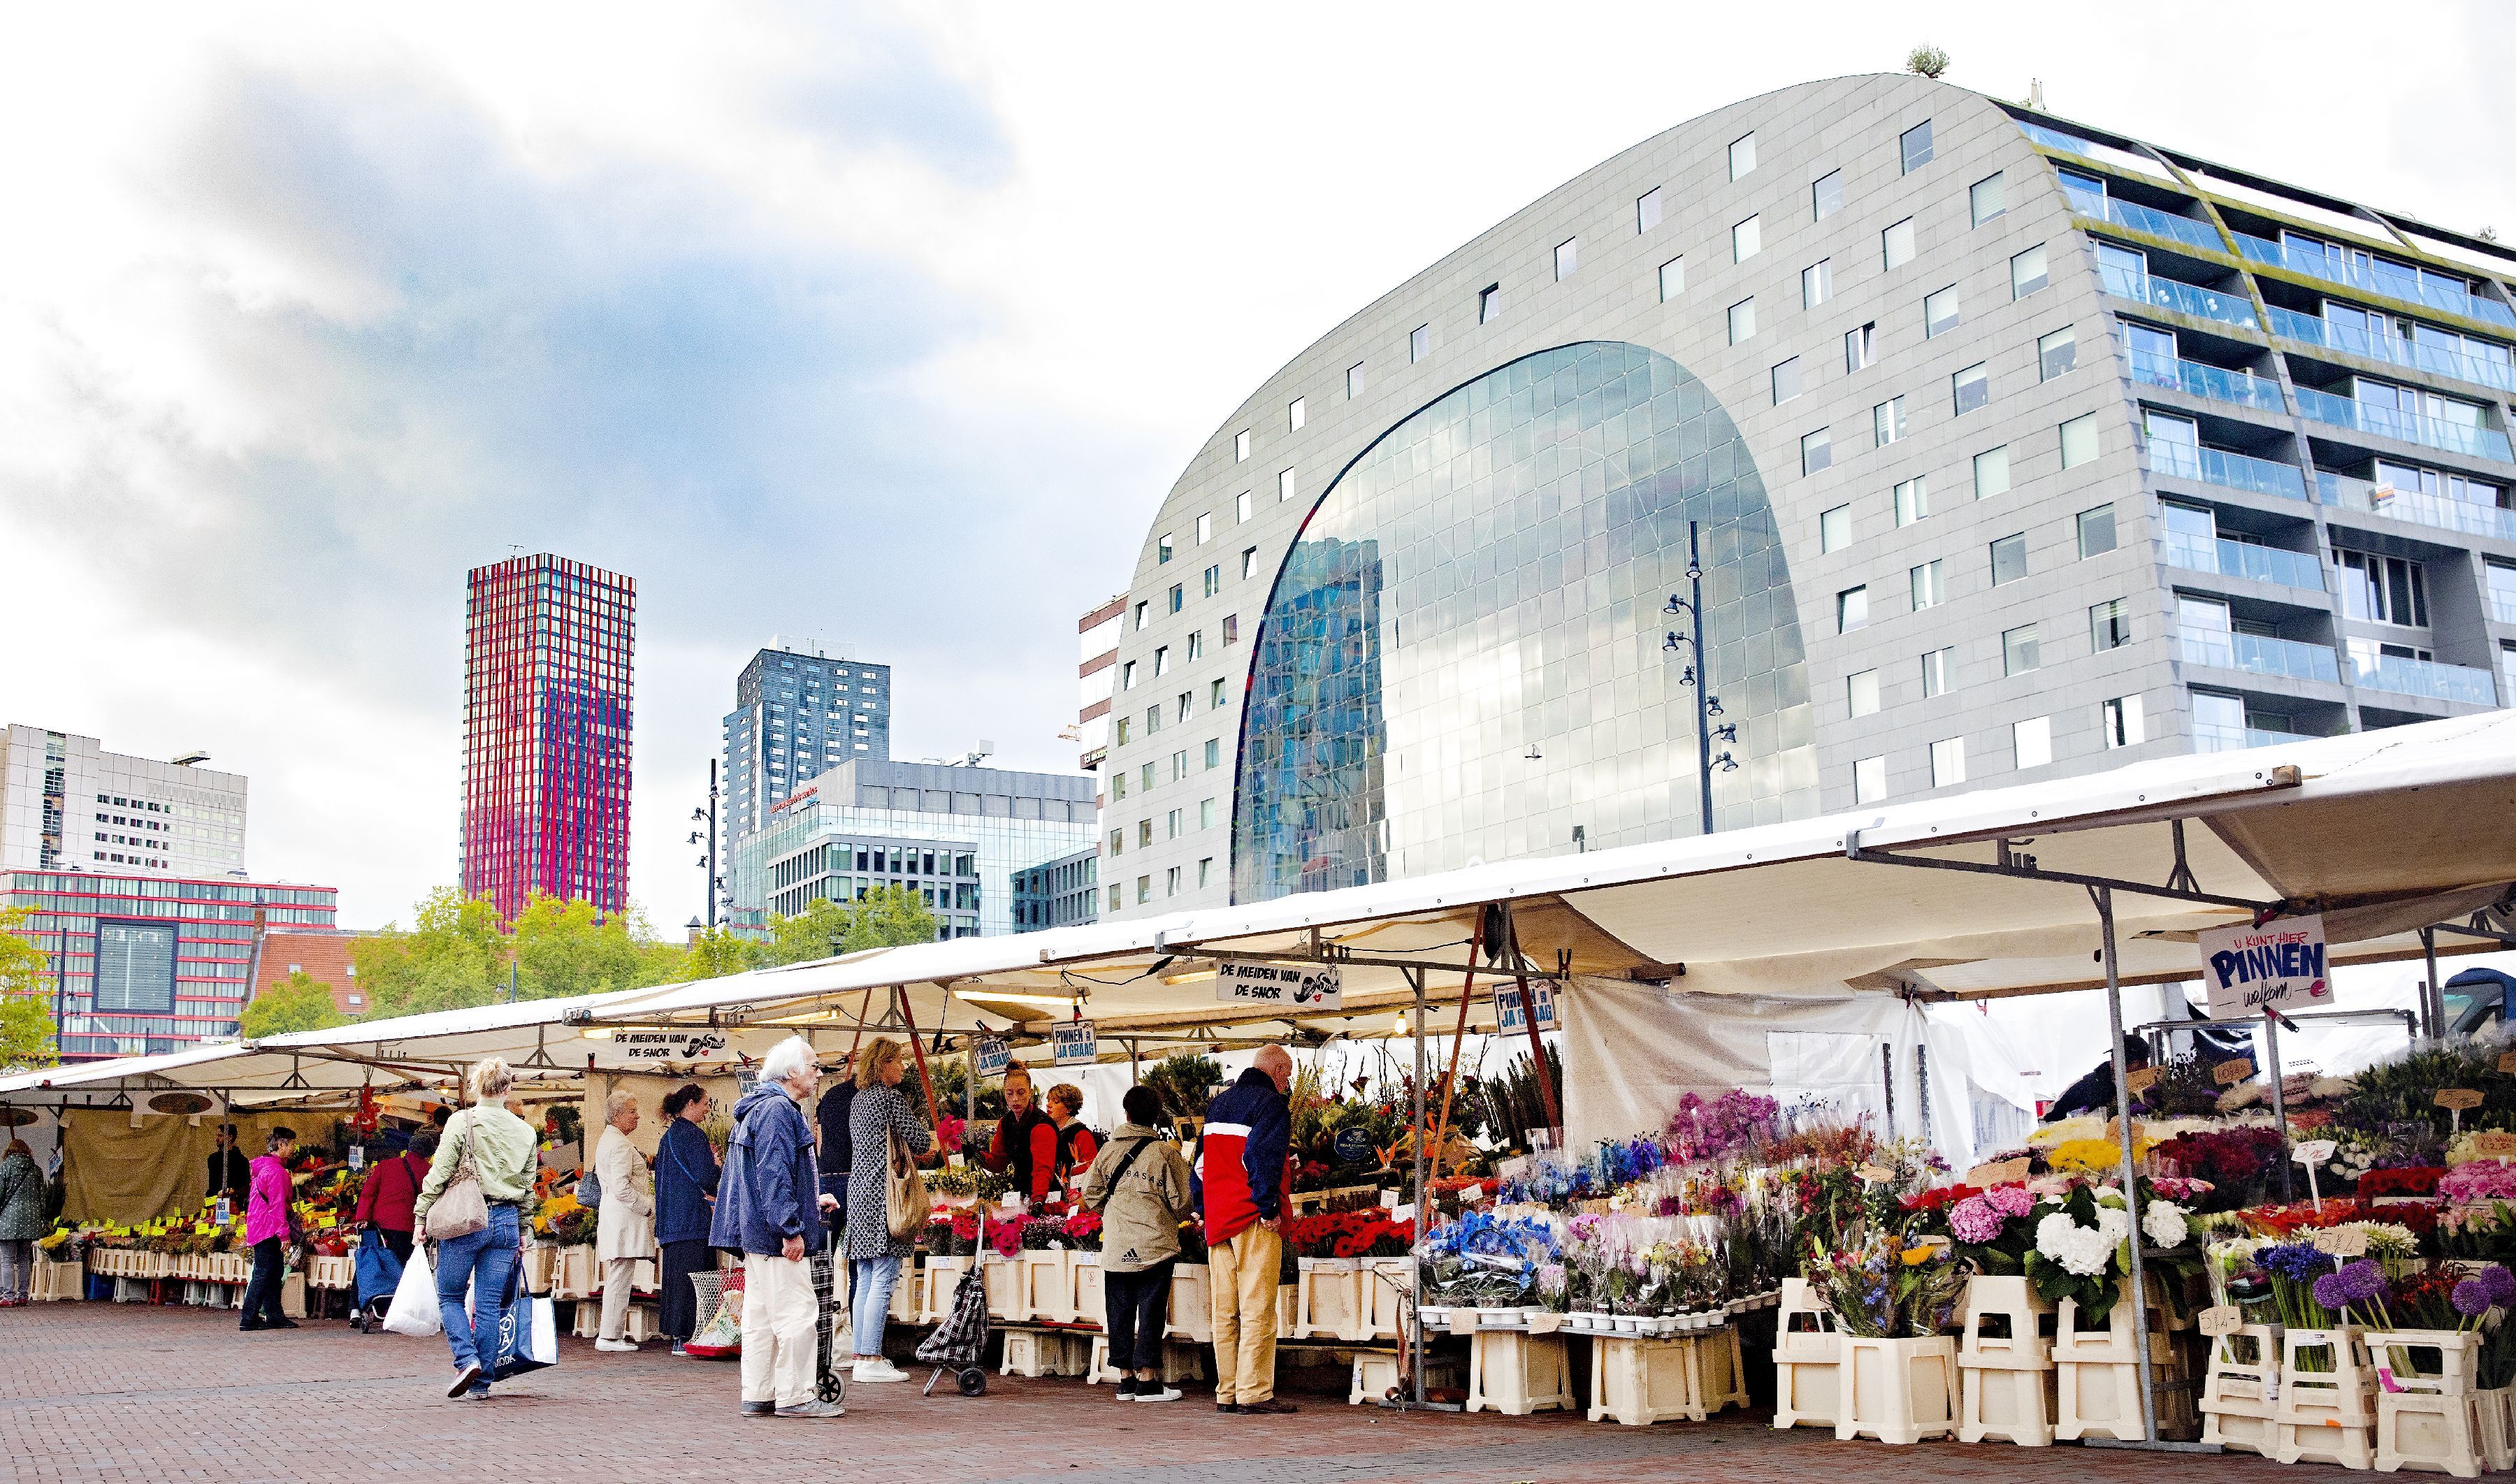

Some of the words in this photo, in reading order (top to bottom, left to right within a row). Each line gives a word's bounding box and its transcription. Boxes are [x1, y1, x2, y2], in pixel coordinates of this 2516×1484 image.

[2234, 939, 2241, 949] U
[2246, 934, 2276, 947] KUNT
[2278, 931, 2308, 944] HIER
[1220, 964, 1235, 976] DE
[1236, 966, 1278, 980] MEIDEN
[1280, 970, 1301, 983] VAN
[2210, 943, 2324, 990] PINNEN
[1235, 984, 1249, 996] DE
[1252, 986, 1282, 999] SNOR
[1498, 989, 1536, 1010] PINNN
[2243, 981, 2292, 1008] welkom
[1502, 1010, 1516, 1027] JA
[1518, 1005, 1552, 1024] GAAG
[615, 1034, 628, 1042] DE
[630, 1034, 666, 1043] MEIDEN
[669, 1034, 688, 1043] VAN
[1055, 1028, 1083, 1044] PINNEN
[629, 1048, 641, 1057] DE
[644, 1048, 670, 1057] SNOR
[1057, 1045, 1067, 1058] JA
[1069, 1042, 1094, 1057] GRAAG
[980, 1057, 989, 1070] JA
[2318, 1232, 2332, 1249] 5
[2201, 1312, 2211, 1330] 5
